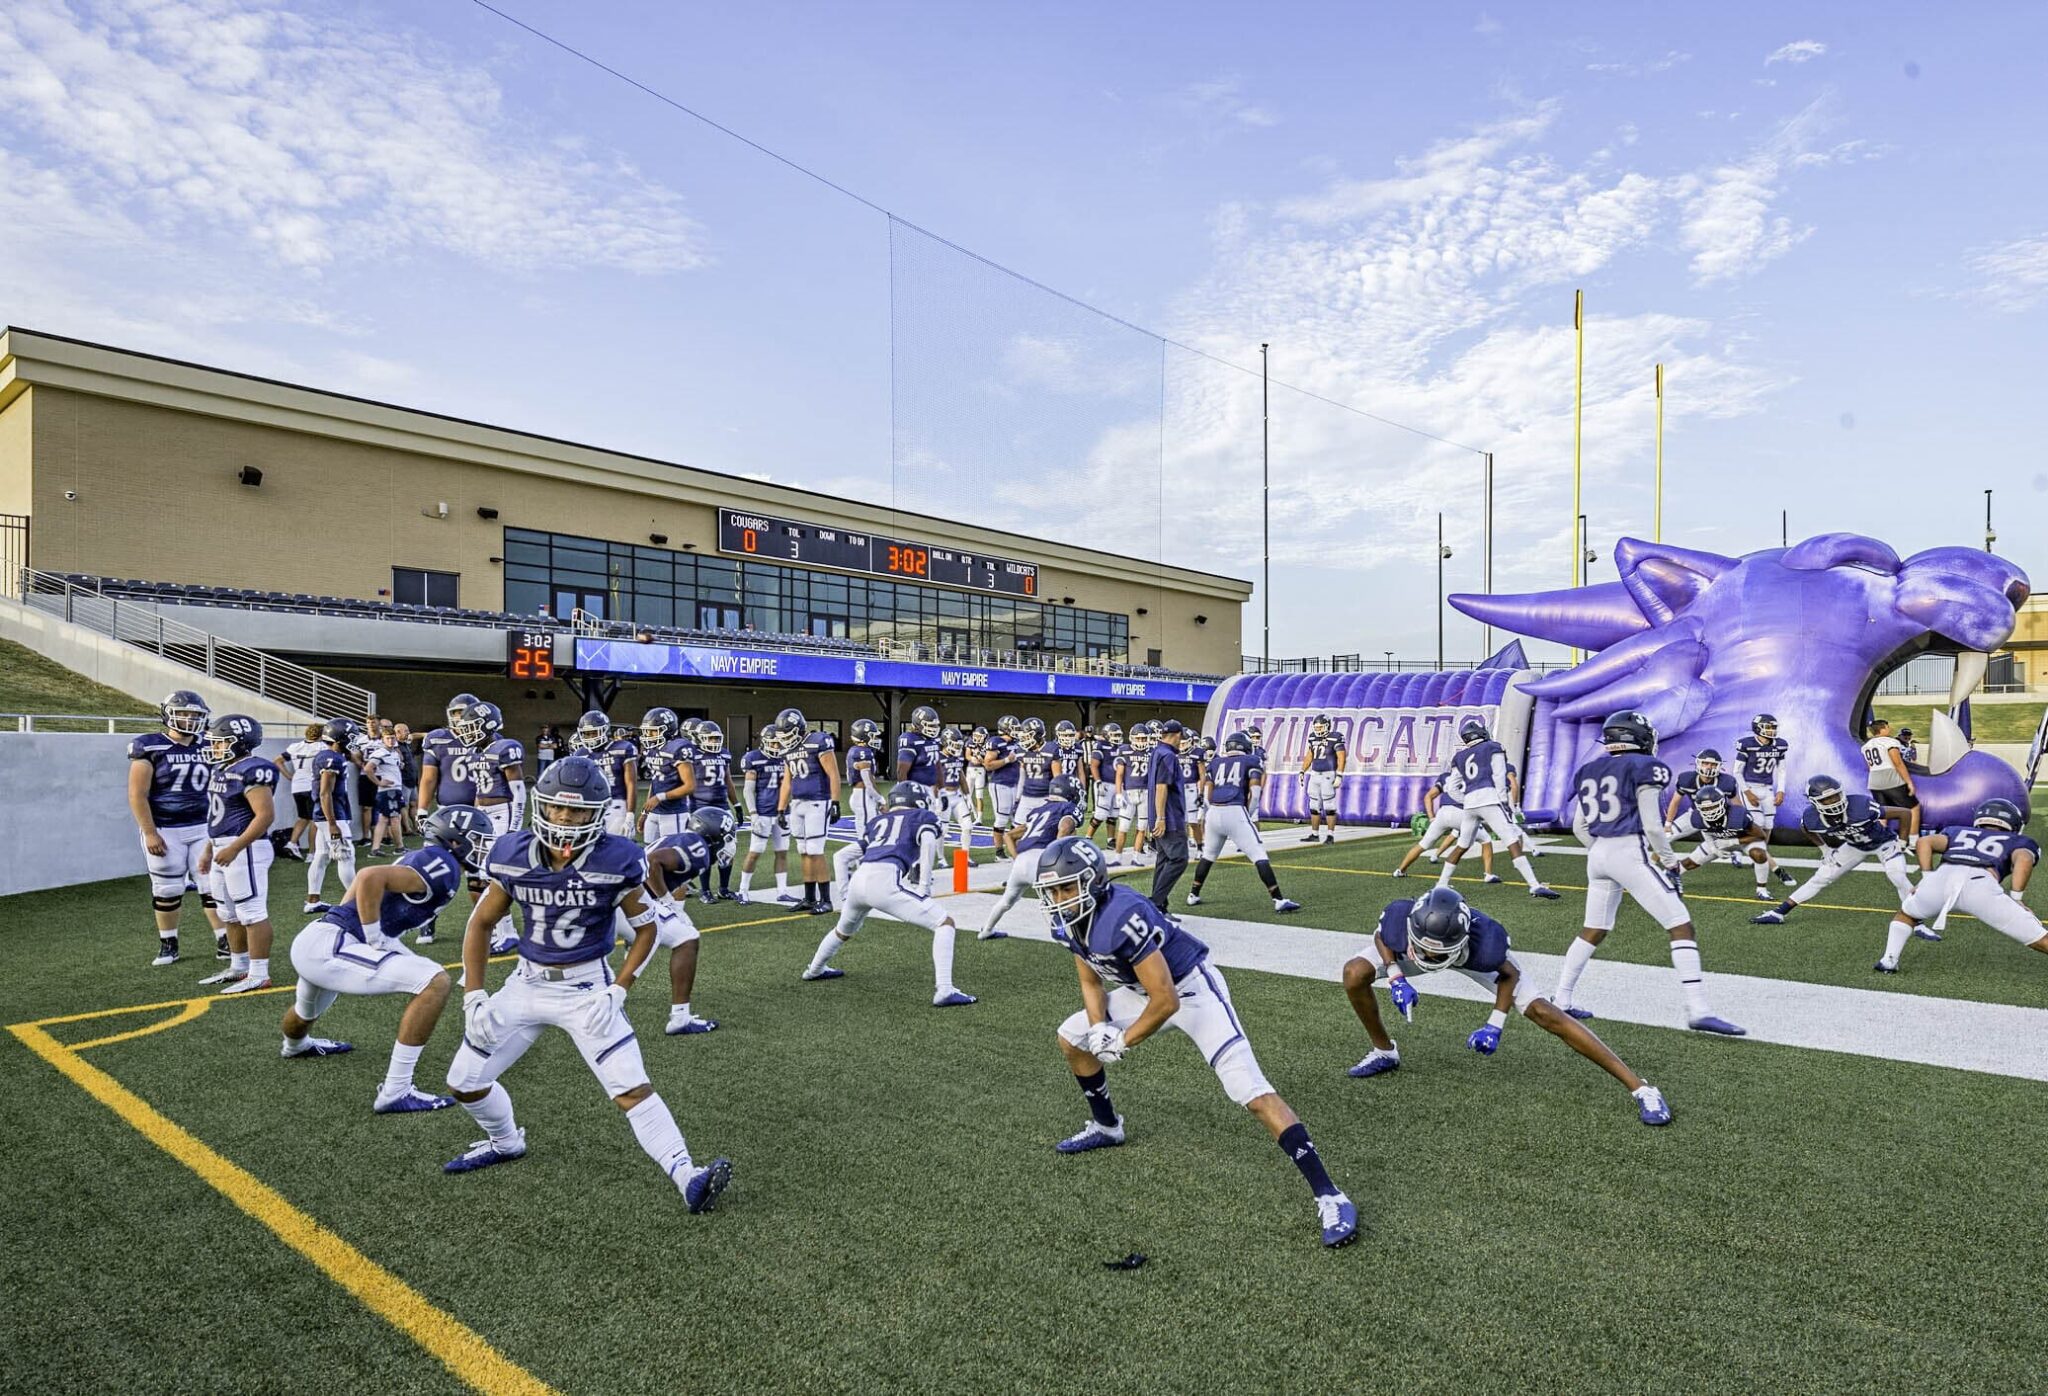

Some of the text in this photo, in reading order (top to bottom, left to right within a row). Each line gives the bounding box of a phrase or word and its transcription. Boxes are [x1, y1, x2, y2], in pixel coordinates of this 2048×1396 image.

[731, 514, 769, 532] COUGARS
[744, 529, 756, 552] 0
[788, 527, 800, 538] TOL
[819, 530, 835, 541] DOWN
[791, 541, 799, 558] 3
[888, 546, 927, 575] 3:02
[967, 566, 971, 583] 1
[1006, 563, 1035, 577] WILDCATS
[988, 573, 995, 588] 3
[1024, 576, 1033, 594] 0
[524, 633, 551, 648] 3:02
[514, 649, 549, 676] 25
[711, 655, 777, 676] NAVY EMPIRE
[941, 670, 988, 688] NAVY EMPIRE
[1111, 682, 1145, 696] NAVY EMPIRE
[474, 704, 491, 717] 80
[660, 711, 674, 724] 35
[229, 718, 252, 734] 99
[345, 723, 353, 732] 7
[864, 723, 871, 732] 5
[1234, 713, 1487, 764] WILDCAT
[166, 753, 210, 764] WILDCAT
[447, 747, 469, 756] WILD
[508, 747, 522, 760] 80
[860, 751, 866, 760] 5
[1865, 747, 1882, 766] 99
[326, 758, 333, 768] 7
[788, 759, 809, 779] 90
[1026, 763, 1044, 779] 42
[1130, 761, 1149, 777] 29
[1465, 753, 1479, 780] 6
[1753, 757, 1777, 774] 30
[169, 764, 209, 792] 70
[255, 768, 273, 783] 99
[704, 765, 725, 787] 54
[945, 768, 961, 783] 25
[1213, 761, 1242, 788] 44
[1652, 766, 1670, 783] 33
[1580, 775, 1622, 824] 33
[449, 810, 473, 829] 17
[720, 814, 735, 832] 19
[867, 815, 905, 849] 21
[687, 841, 706, 858] 19
[1949, 829, 2010, 859] 56
[1071, 840, 1099, 866] 15
[422, 856, 451, 879] 17
[513, 885, 597, 907] WILDCATS
[528, 903, 588, 949] 16
[1120, 912, 1149, 947] 15
